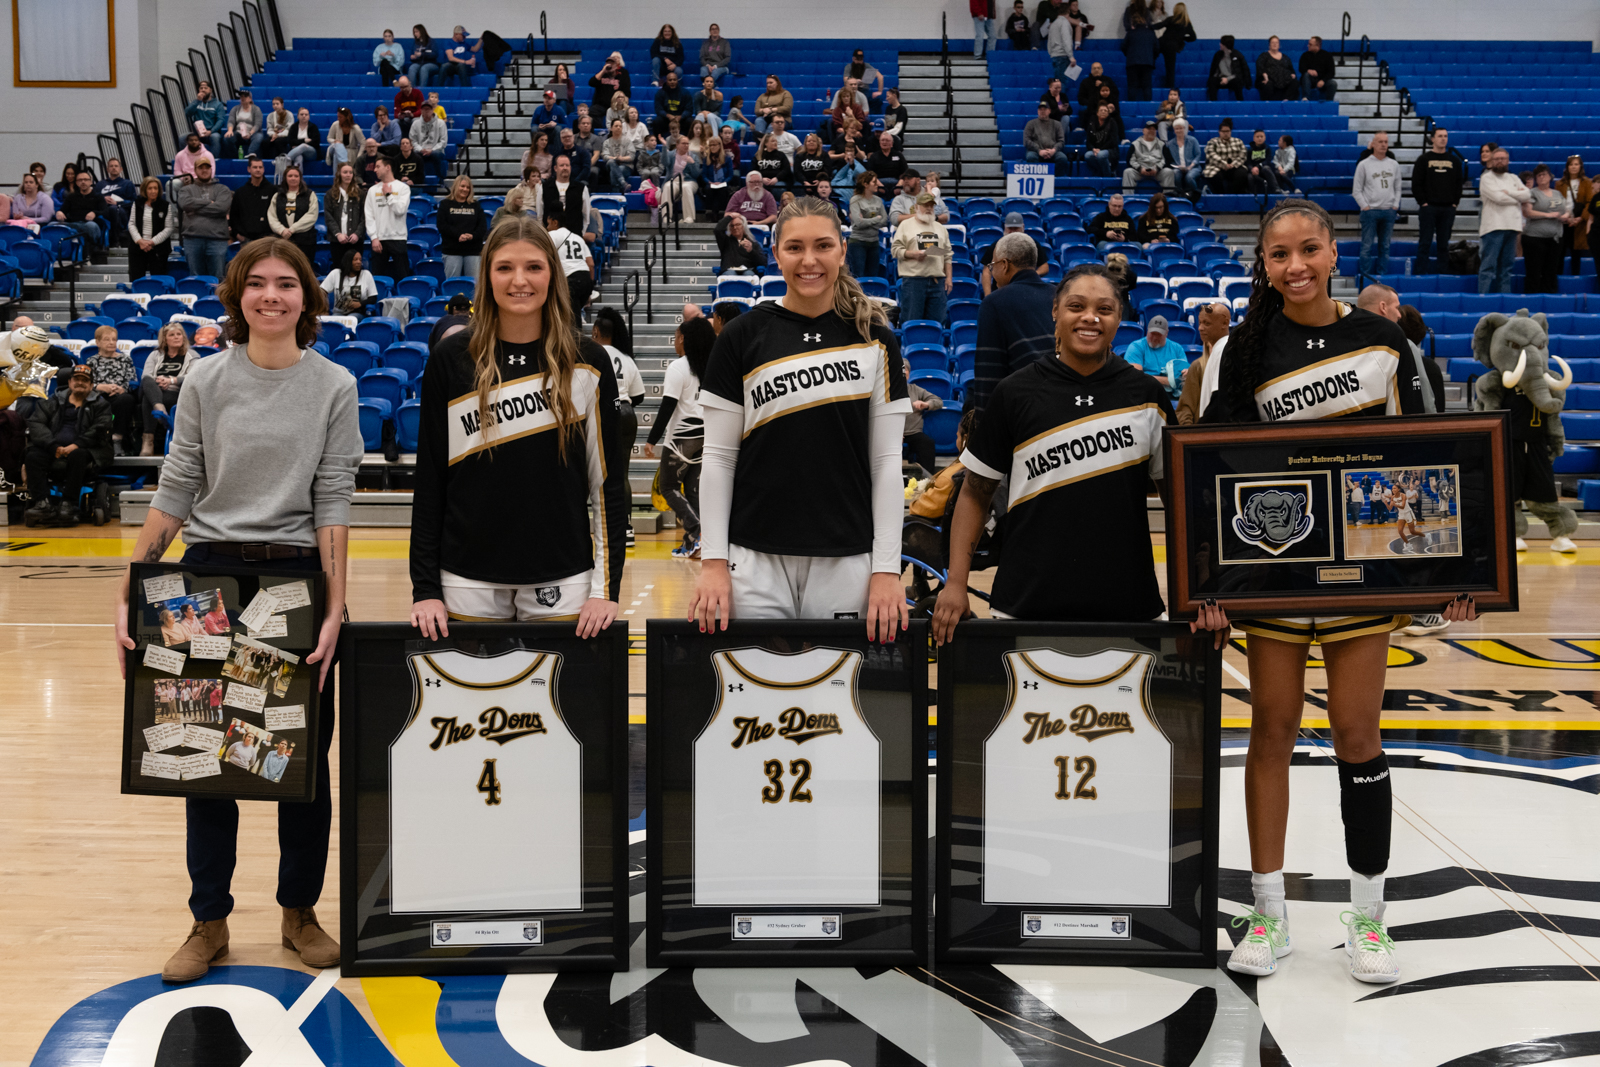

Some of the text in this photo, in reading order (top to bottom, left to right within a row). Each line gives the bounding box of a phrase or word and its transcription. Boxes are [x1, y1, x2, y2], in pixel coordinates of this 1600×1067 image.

[1013, 164, 1049, 174] SECTION
[1017, 177, 1045, 196] 107
[564, 240, 584, 260] 12
[13, 348, 39, 361] GRA
[662, 360, 668, 368] E
[652, 386, 660, 394] D
[751, 360, 861, 410] MASTODONS
[1262, 370, 1360, 422] MASTODONS
[642, 414, 650, 422] C
[632, 446, 640, 454] B
[1025, 425, 1134, 480] MASTODONS
[1288, 454, 1384, 466] Purdue University Fort Wayne
[429, 706, 548, 752] The Dons
[731, 706, 843, 749] The Dons
[1022, 704, 1135, 744] The Dons
[476, 758, 501, 806] 4
[762, 757, 813, 804] 32
[1054, 755, 1098, 800] 12
